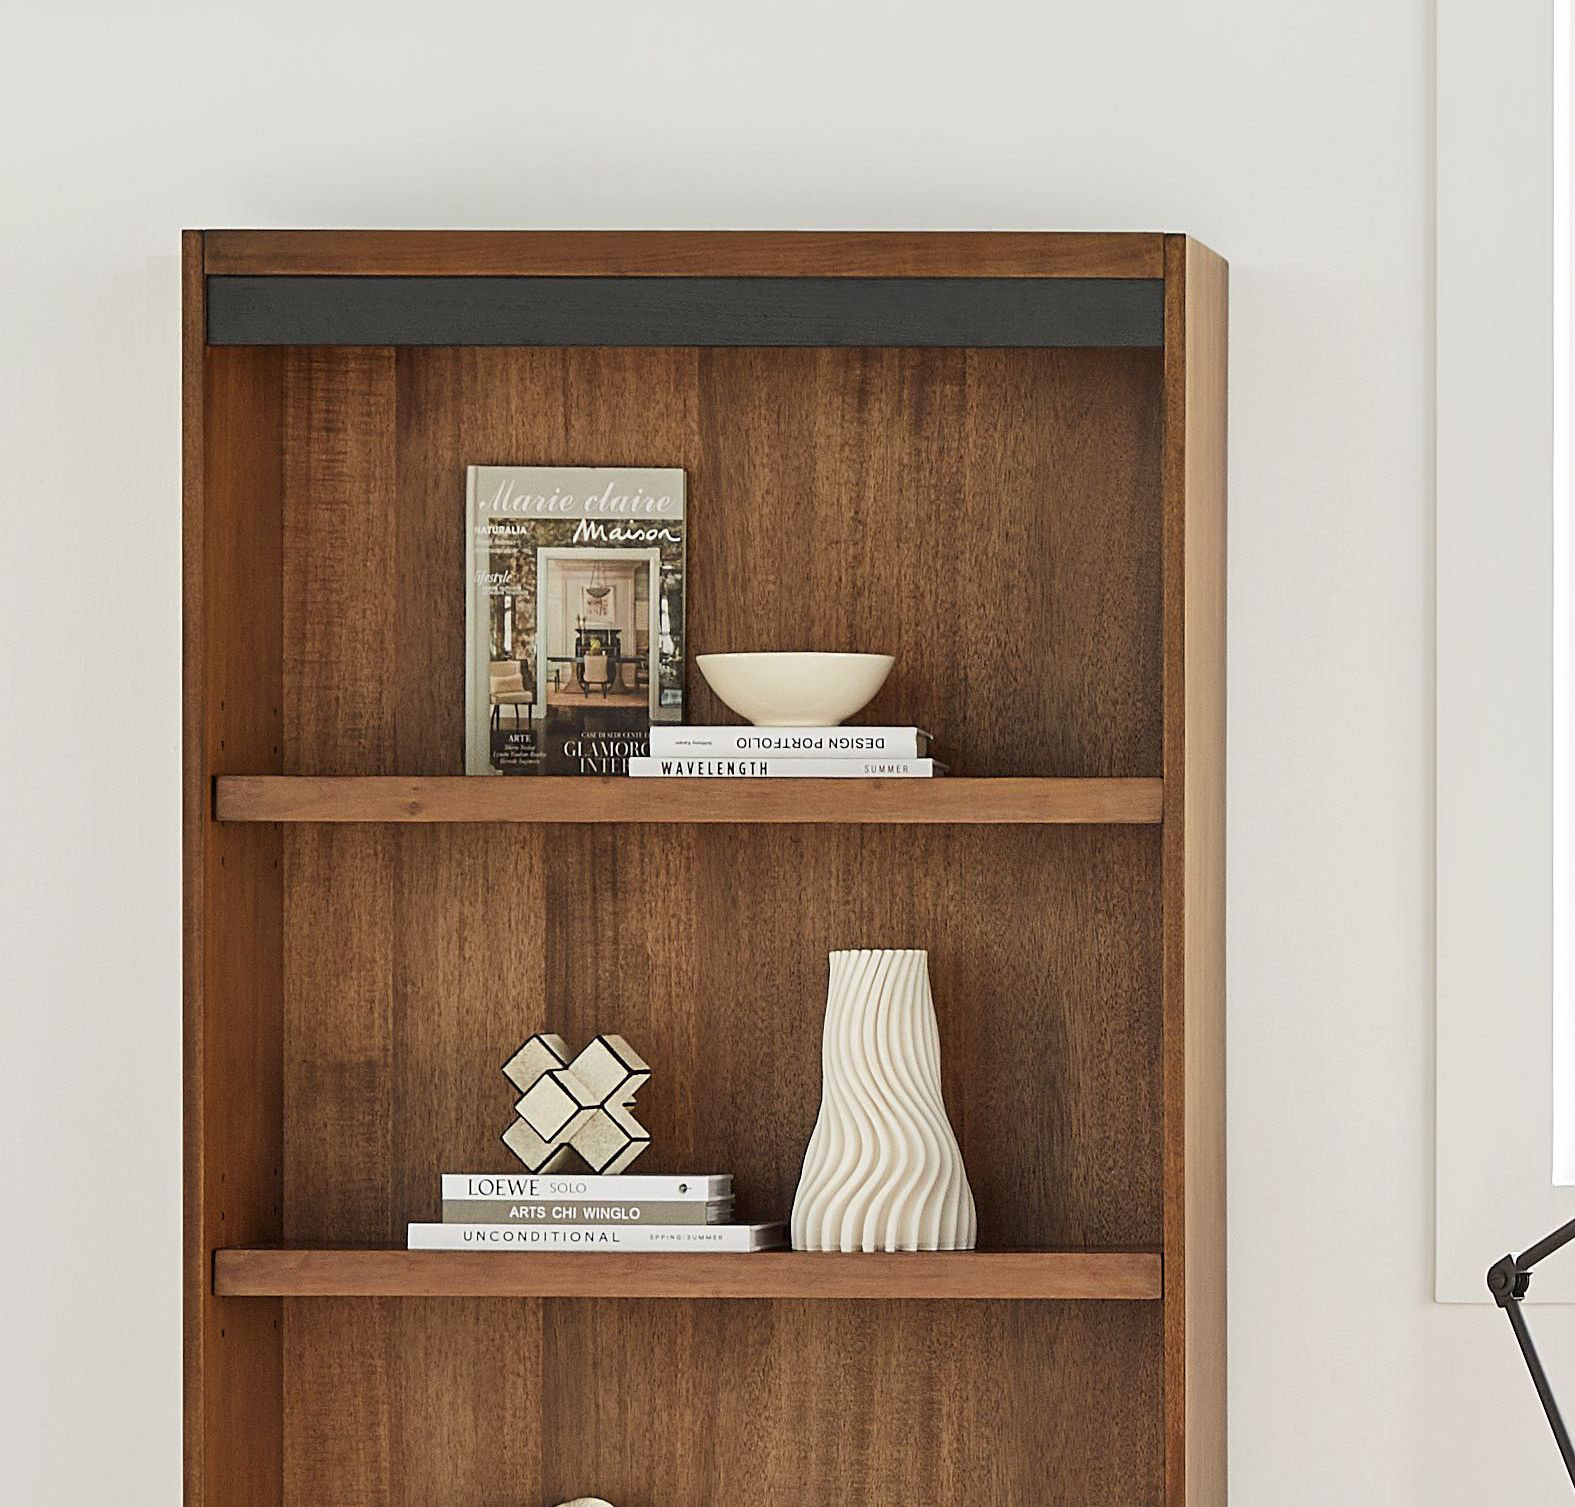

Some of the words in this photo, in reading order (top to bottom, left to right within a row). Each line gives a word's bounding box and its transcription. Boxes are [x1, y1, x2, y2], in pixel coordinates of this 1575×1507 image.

[479, 479, 574, 512] Marie
[584, 481, 673, 512] claire
[572, 517, 682, 543] Maison
[508, 734, 532, 743] ARTE
[736, 737, 823, 749] PORTFOLIO
[829, 737, 885, 749] DESIGN
[661, 761, 768, 775] WAVELENGTH
[864, 764, 909, 774] SUMMER
[468, 1178, 540, 1196] LOEWE
[550, 1182, 587, 1194] SOLO
[509, 1206, 546, 1219] ARTS
[552, 1206, 577, 1219] CHI
[583, 1207, 641, 1220] WINGLO
[463, 1231, 620, 1243] UNCONDITIONAL
